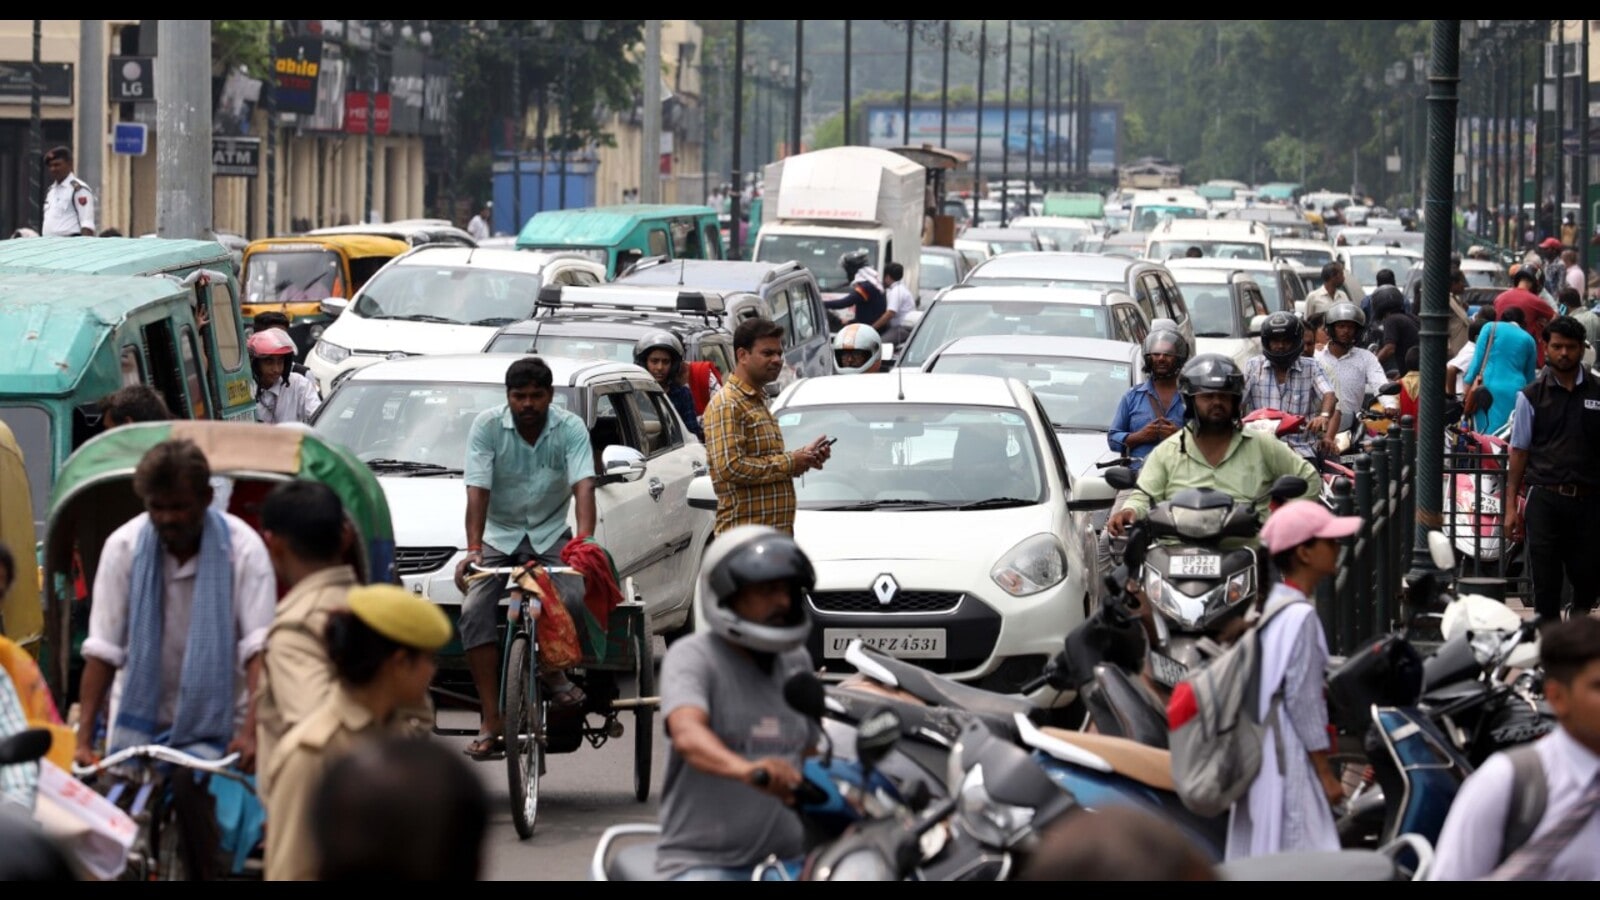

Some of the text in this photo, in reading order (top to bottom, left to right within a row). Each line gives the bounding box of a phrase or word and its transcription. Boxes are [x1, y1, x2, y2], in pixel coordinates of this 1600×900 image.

[122, 82, 143, 96] LG
[349, 107, 389, 119] MERO
[213, 150, 251, 164] ATM
[833, 638, 937, 651] UP2FZ4531
